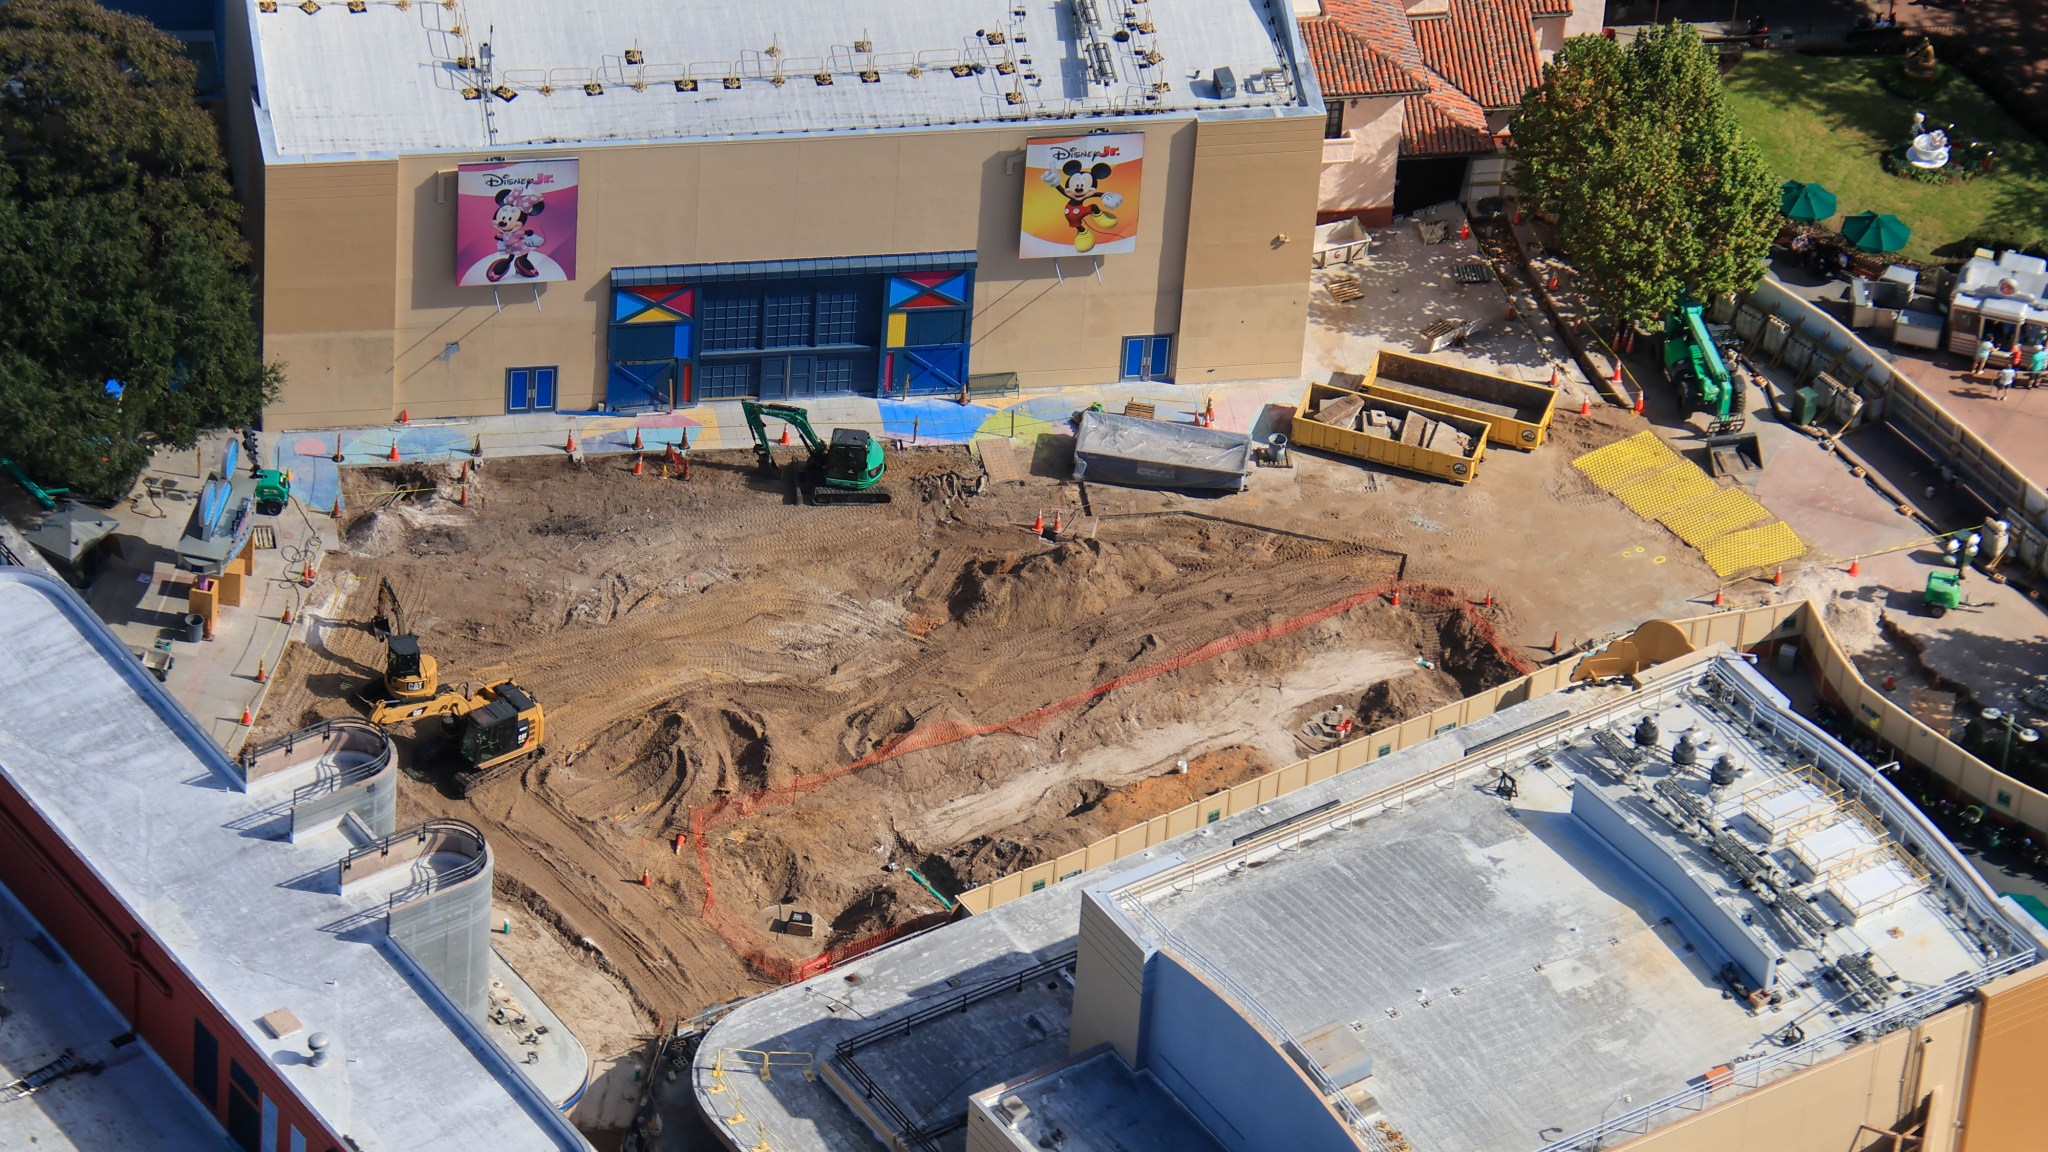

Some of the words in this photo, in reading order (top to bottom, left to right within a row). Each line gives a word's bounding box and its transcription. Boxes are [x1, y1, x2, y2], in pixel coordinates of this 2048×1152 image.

[1050, 147, 1100, 162] Disney
[1099, 146, 1120, 157] Jr.
[482, 173, 534, 189] Disney
[533, 173, 555, 185] Jr.
[408, 682, 423, 690] CAT
[413, 709, 423, 717] CAT
